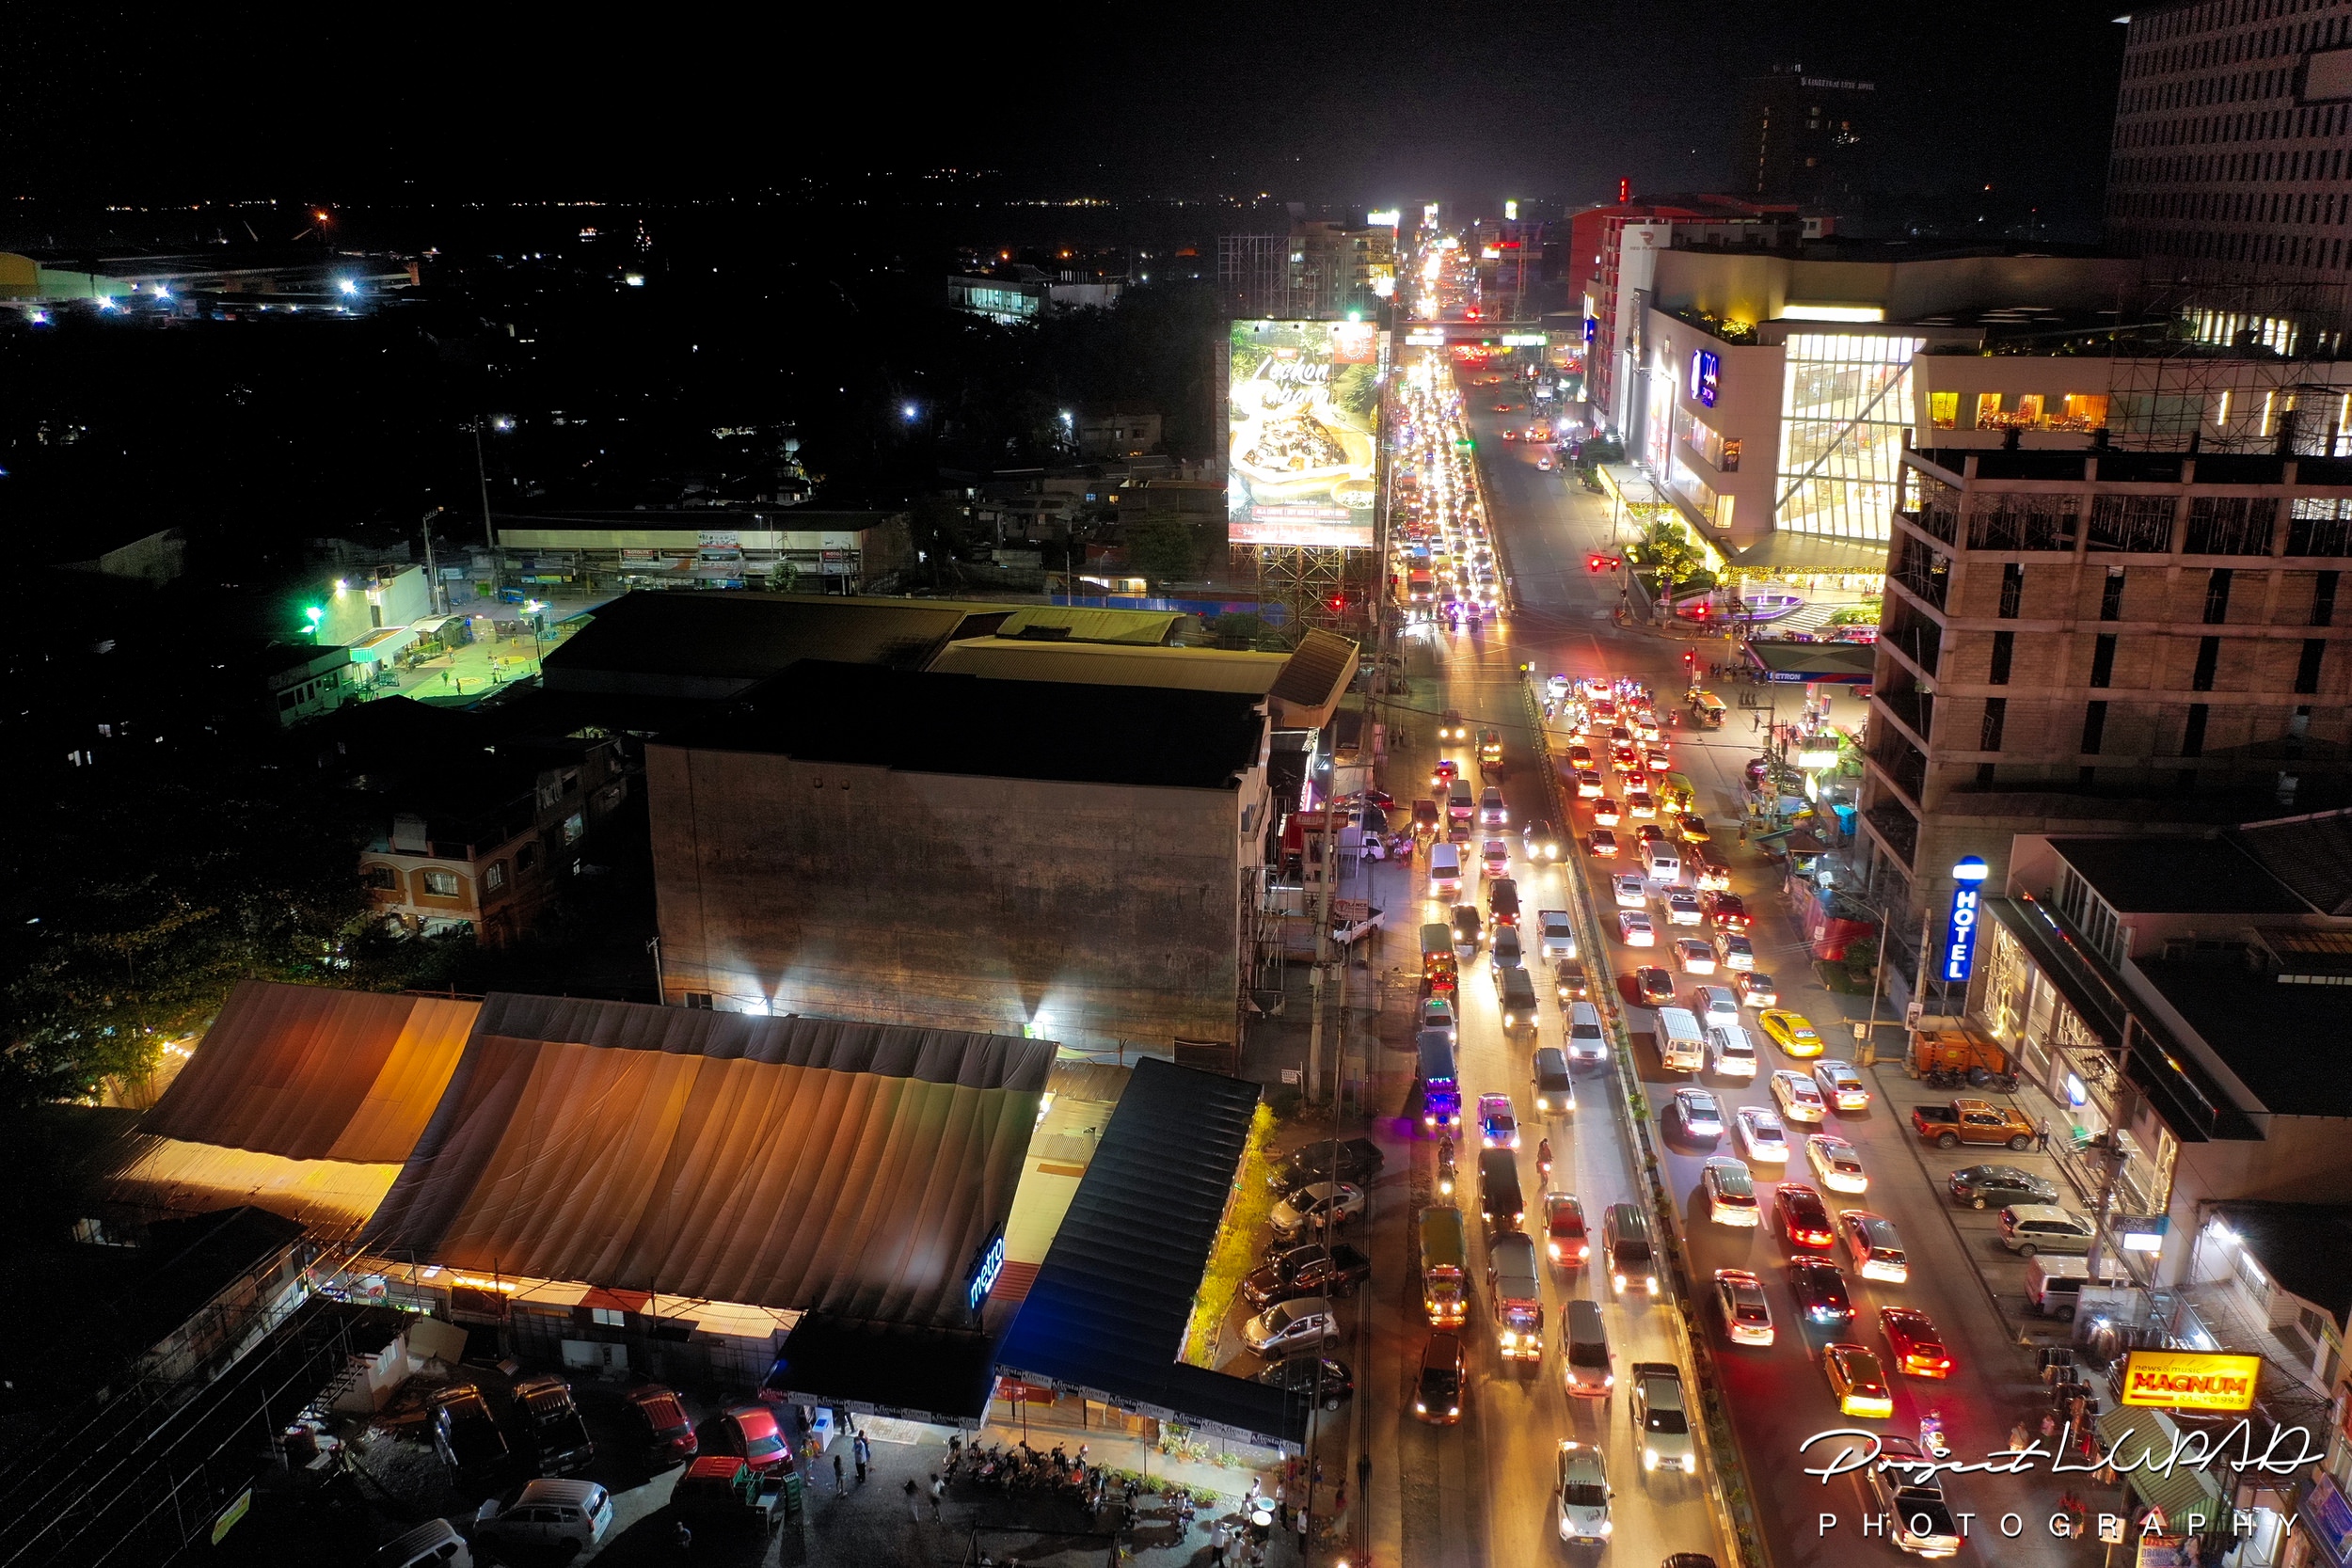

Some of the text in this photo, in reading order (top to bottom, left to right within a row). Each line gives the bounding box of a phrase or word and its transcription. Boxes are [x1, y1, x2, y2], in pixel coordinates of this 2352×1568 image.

[1948, 891, 1977, 978] HOTEL
[2115, 1224, 2153, 1232] AVENUE
[2123, 1217, 2145, 1226] ONE
[970, 1237, 1003, 1309] metro
[2132, 1372, 2248, 1395] MAGNUM
[2178, 1394, 2245, 1404] RADYO 99.9
